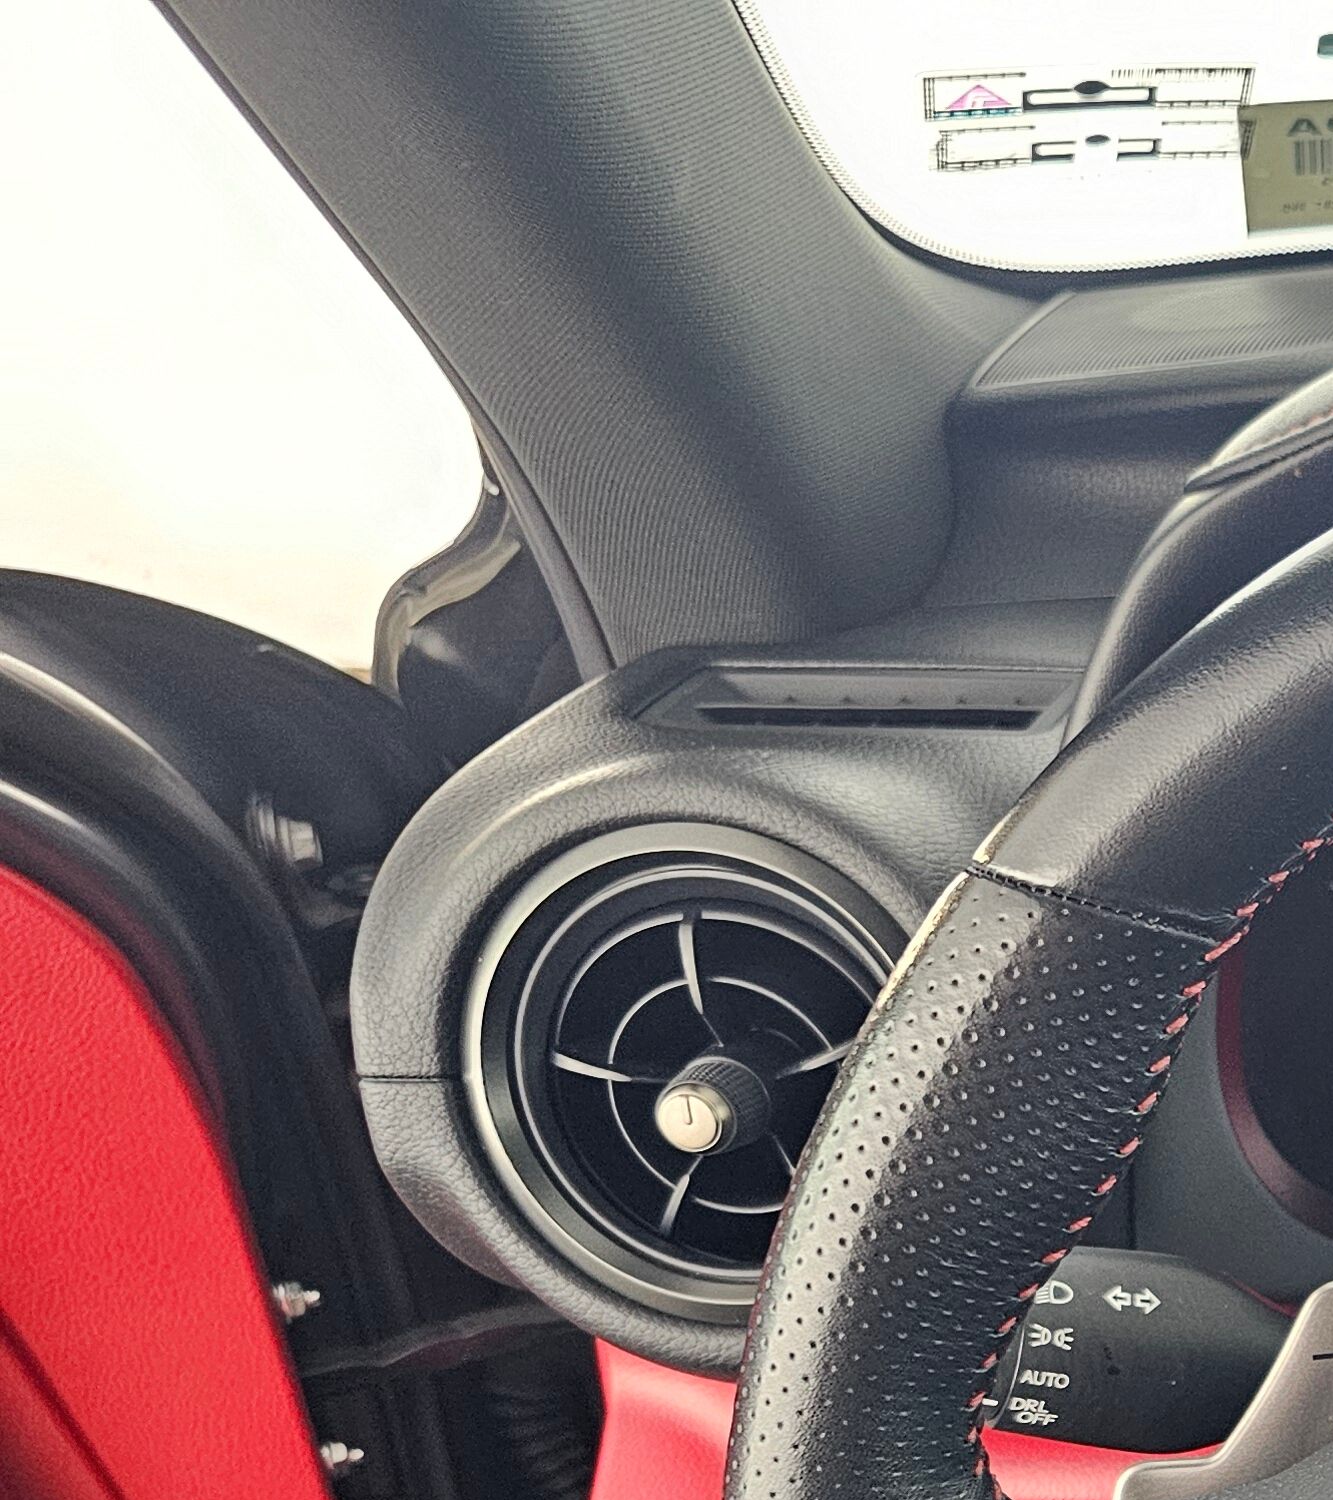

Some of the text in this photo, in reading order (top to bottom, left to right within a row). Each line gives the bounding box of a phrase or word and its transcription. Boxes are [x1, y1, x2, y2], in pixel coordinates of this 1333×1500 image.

[1019, 1369, 1070, 1390] AUTO
[1009, 1396, 1050, 1413] DRL
[1015, 1411, 1059, 1427] OFF
